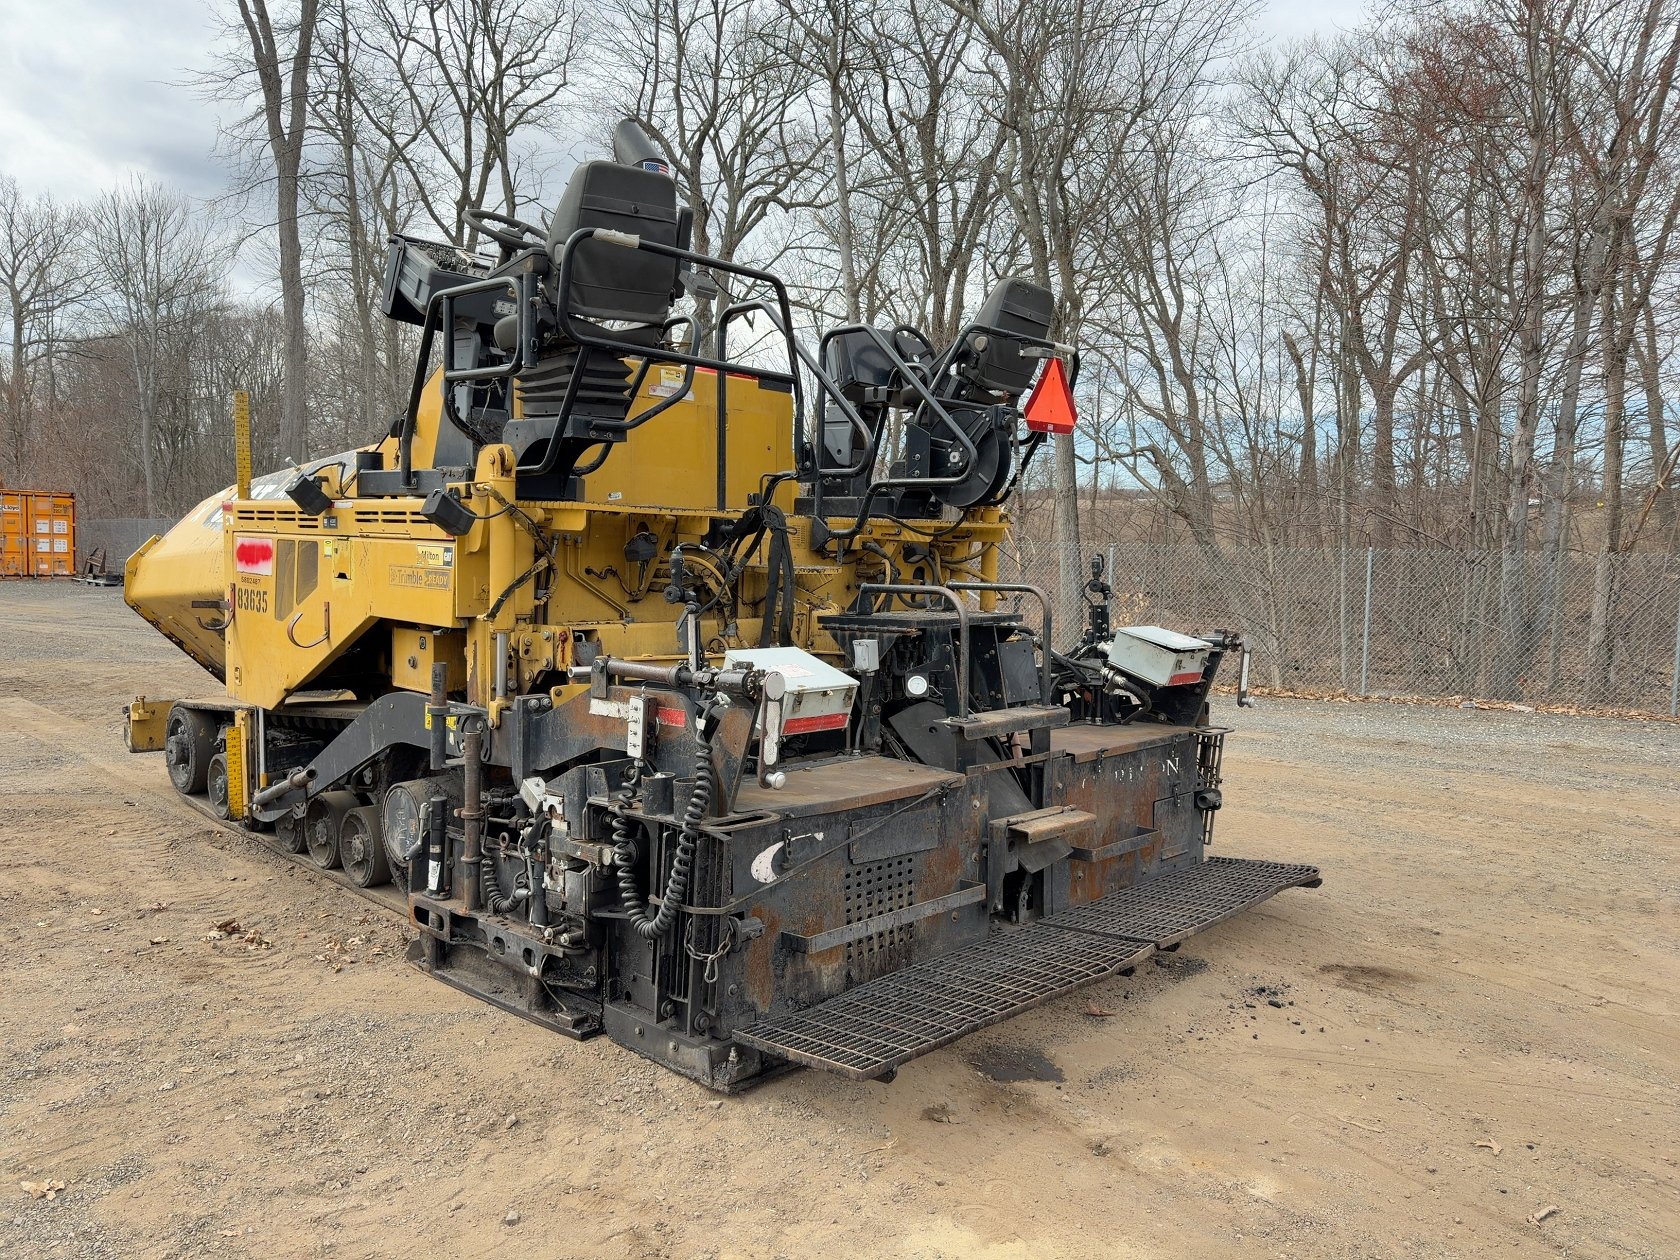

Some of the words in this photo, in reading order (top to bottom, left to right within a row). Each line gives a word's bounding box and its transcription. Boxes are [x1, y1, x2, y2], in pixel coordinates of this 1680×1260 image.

[421, 550, 440, 560] Milton
[397, 569, 423, 585] Trimble
[428, 575, 448, 585] READY
[237, 587, 268, 613] 83635
